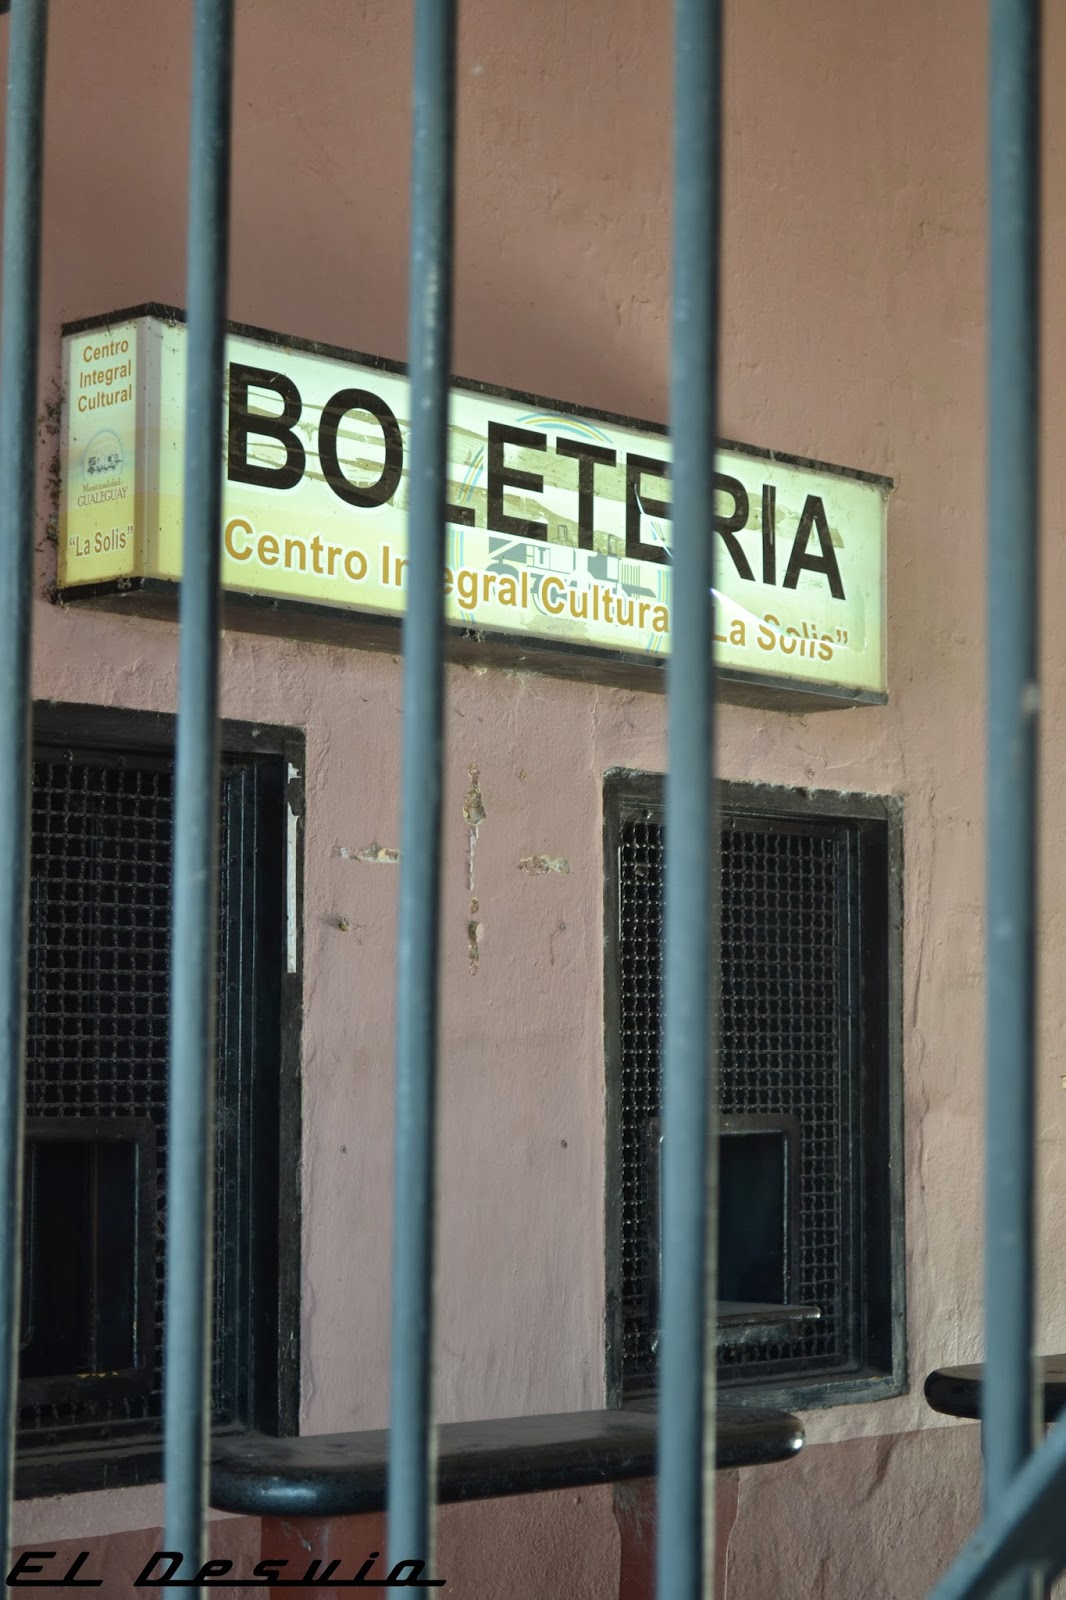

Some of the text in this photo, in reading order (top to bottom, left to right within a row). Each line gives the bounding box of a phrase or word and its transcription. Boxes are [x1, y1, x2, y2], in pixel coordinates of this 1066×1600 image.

[83, 340, 129, 363] Centro
[80, 359, 132, 388] Integral
[78, 383, 132, 412] Cultural
[228, 361, 846, 601] BOETERIA
[77, 486, 128, 507] GUALEGUAY
[224, 518, 368, 581] Centro
[541, 576, 670, 633] Cultura
